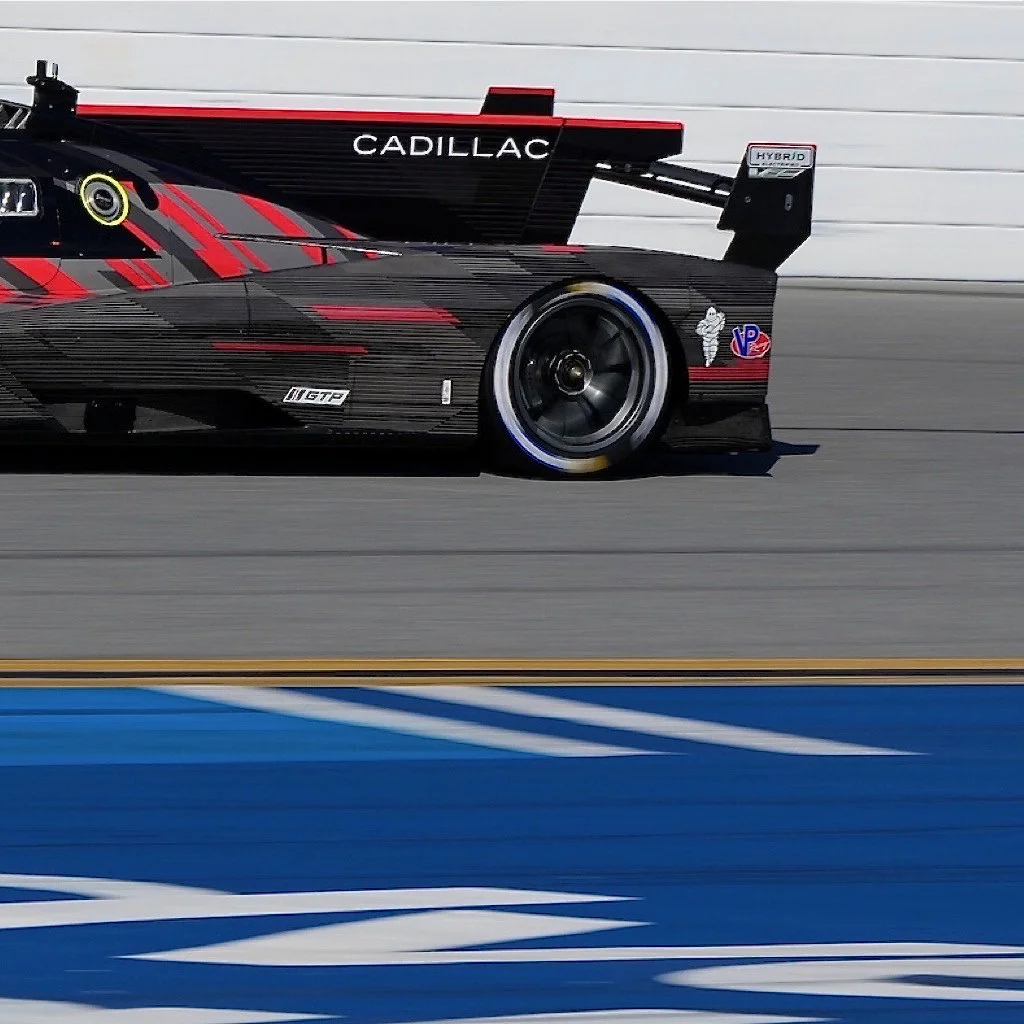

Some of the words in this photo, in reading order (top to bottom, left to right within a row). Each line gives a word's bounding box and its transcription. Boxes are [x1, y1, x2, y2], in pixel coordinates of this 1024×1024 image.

[353, 133, 551, 159] CADILLAC
[756, 152, 805, 161] HYBRID
[733, 324, 760, 357] VP
[304, 390, 345, 403] GTP
